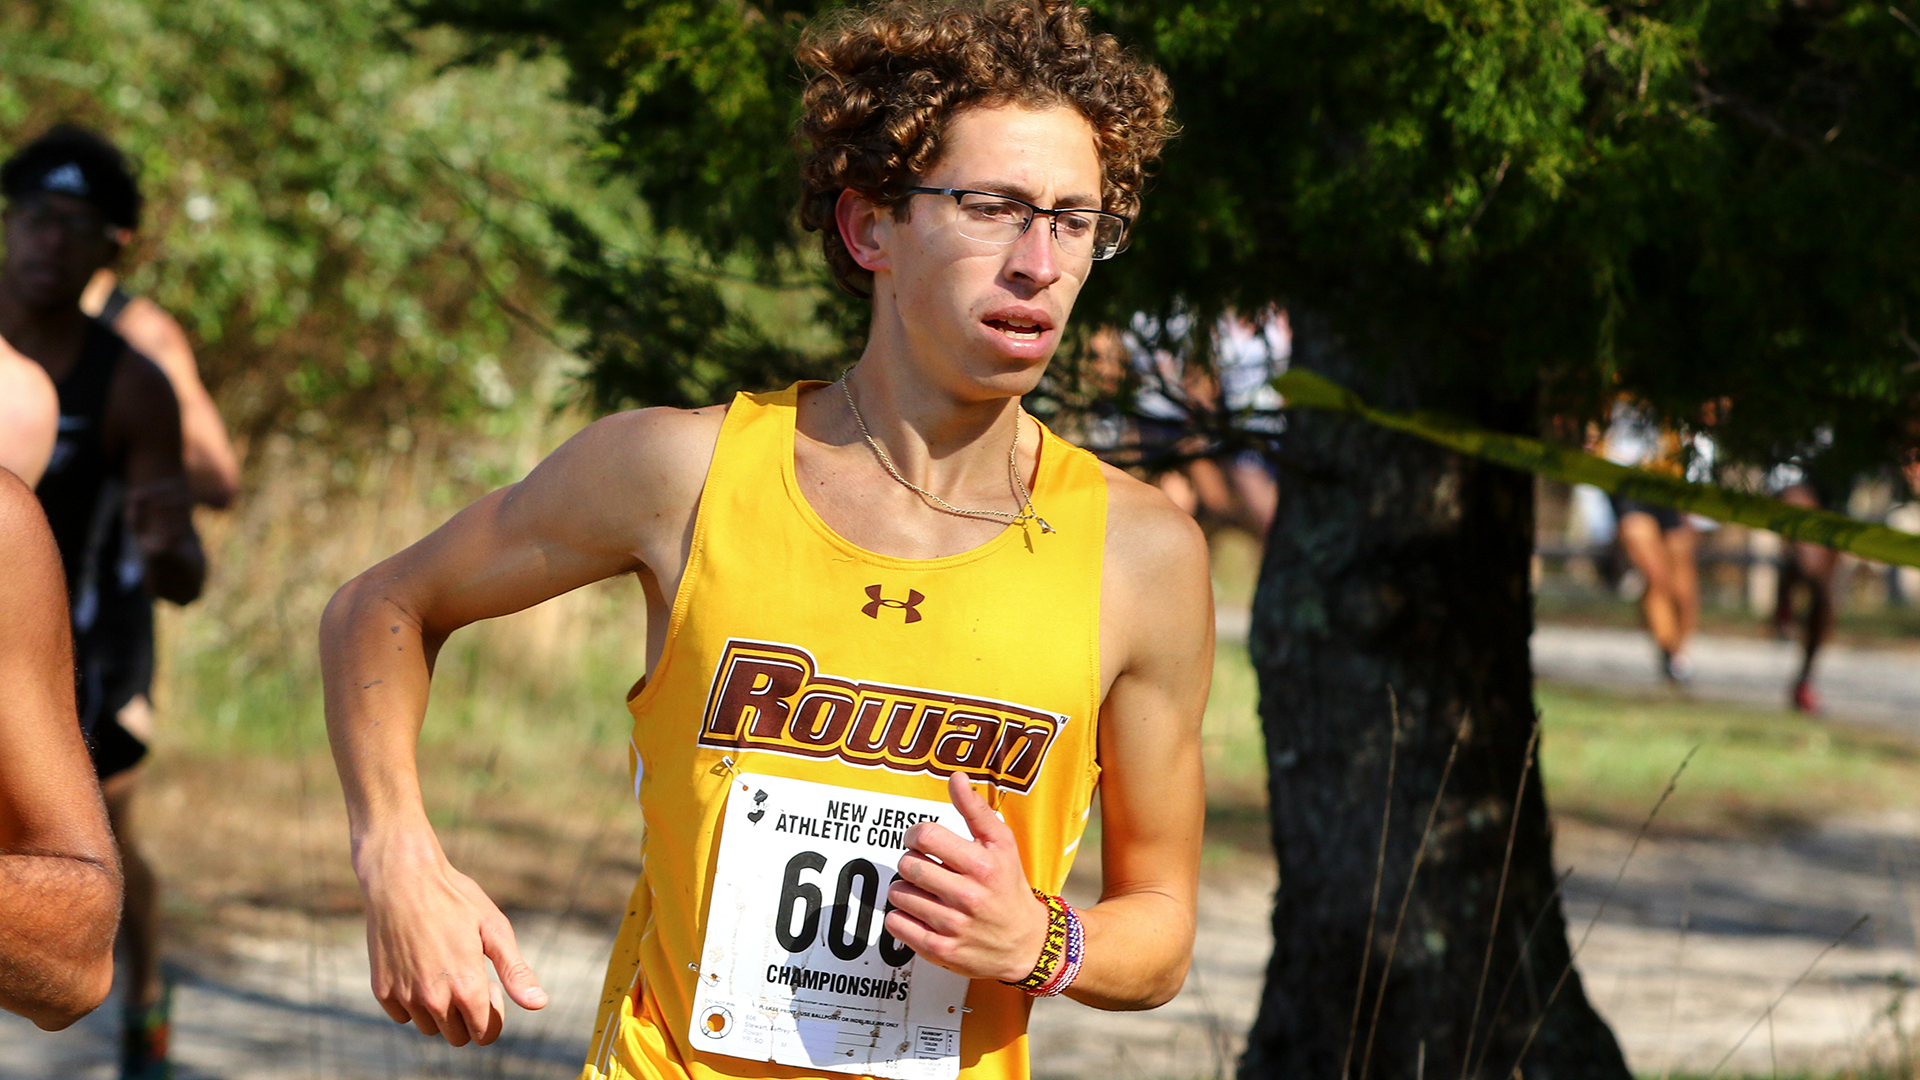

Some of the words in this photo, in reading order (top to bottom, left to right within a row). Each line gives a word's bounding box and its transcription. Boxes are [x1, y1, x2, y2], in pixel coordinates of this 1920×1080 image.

[702, 642, 1056, 792] Rowan
[827, 800, 868, 823] NEW
[775, 813, 861, 843] ATHLETIC
[866, 827, 907, 851] CON
[766, 964, 909, 1001] CHAMPIONSHIPS
